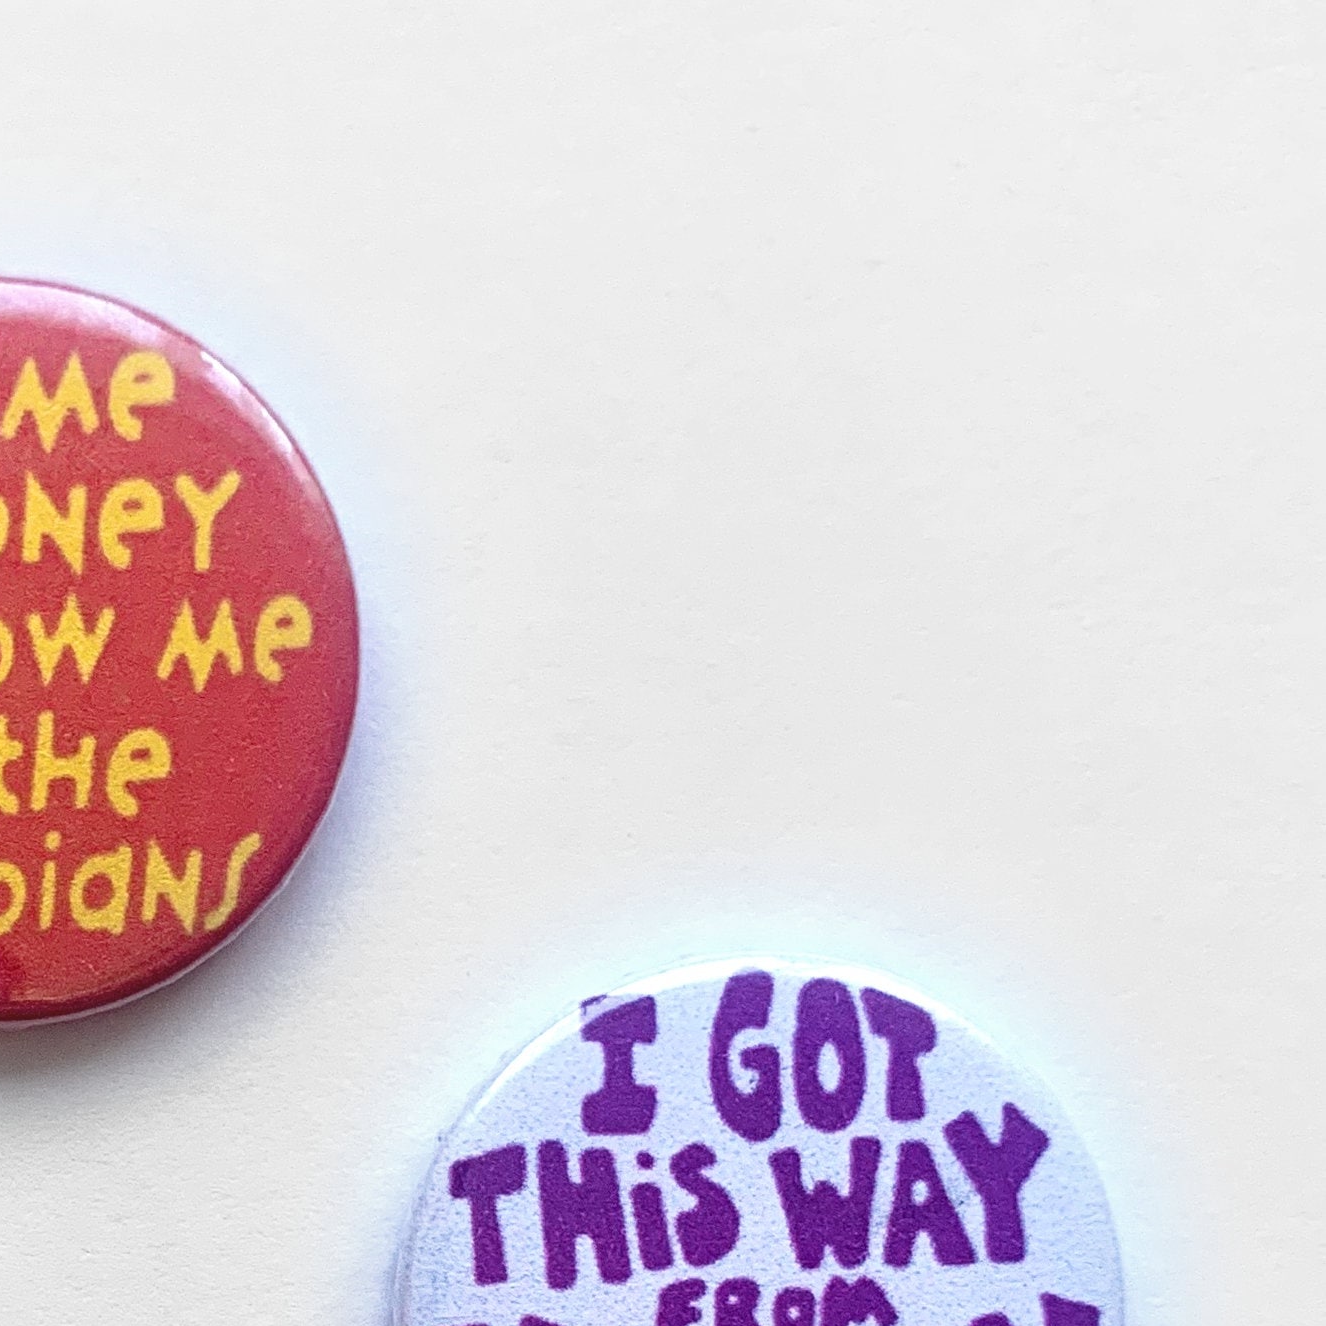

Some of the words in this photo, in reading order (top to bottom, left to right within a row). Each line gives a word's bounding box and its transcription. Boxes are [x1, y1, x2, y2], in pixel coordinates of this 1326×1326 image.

[579, 994, 659, 1136] I
[708, 969, 937, 1142] GOT
[768, 1101, 1051, 1270] WAY
